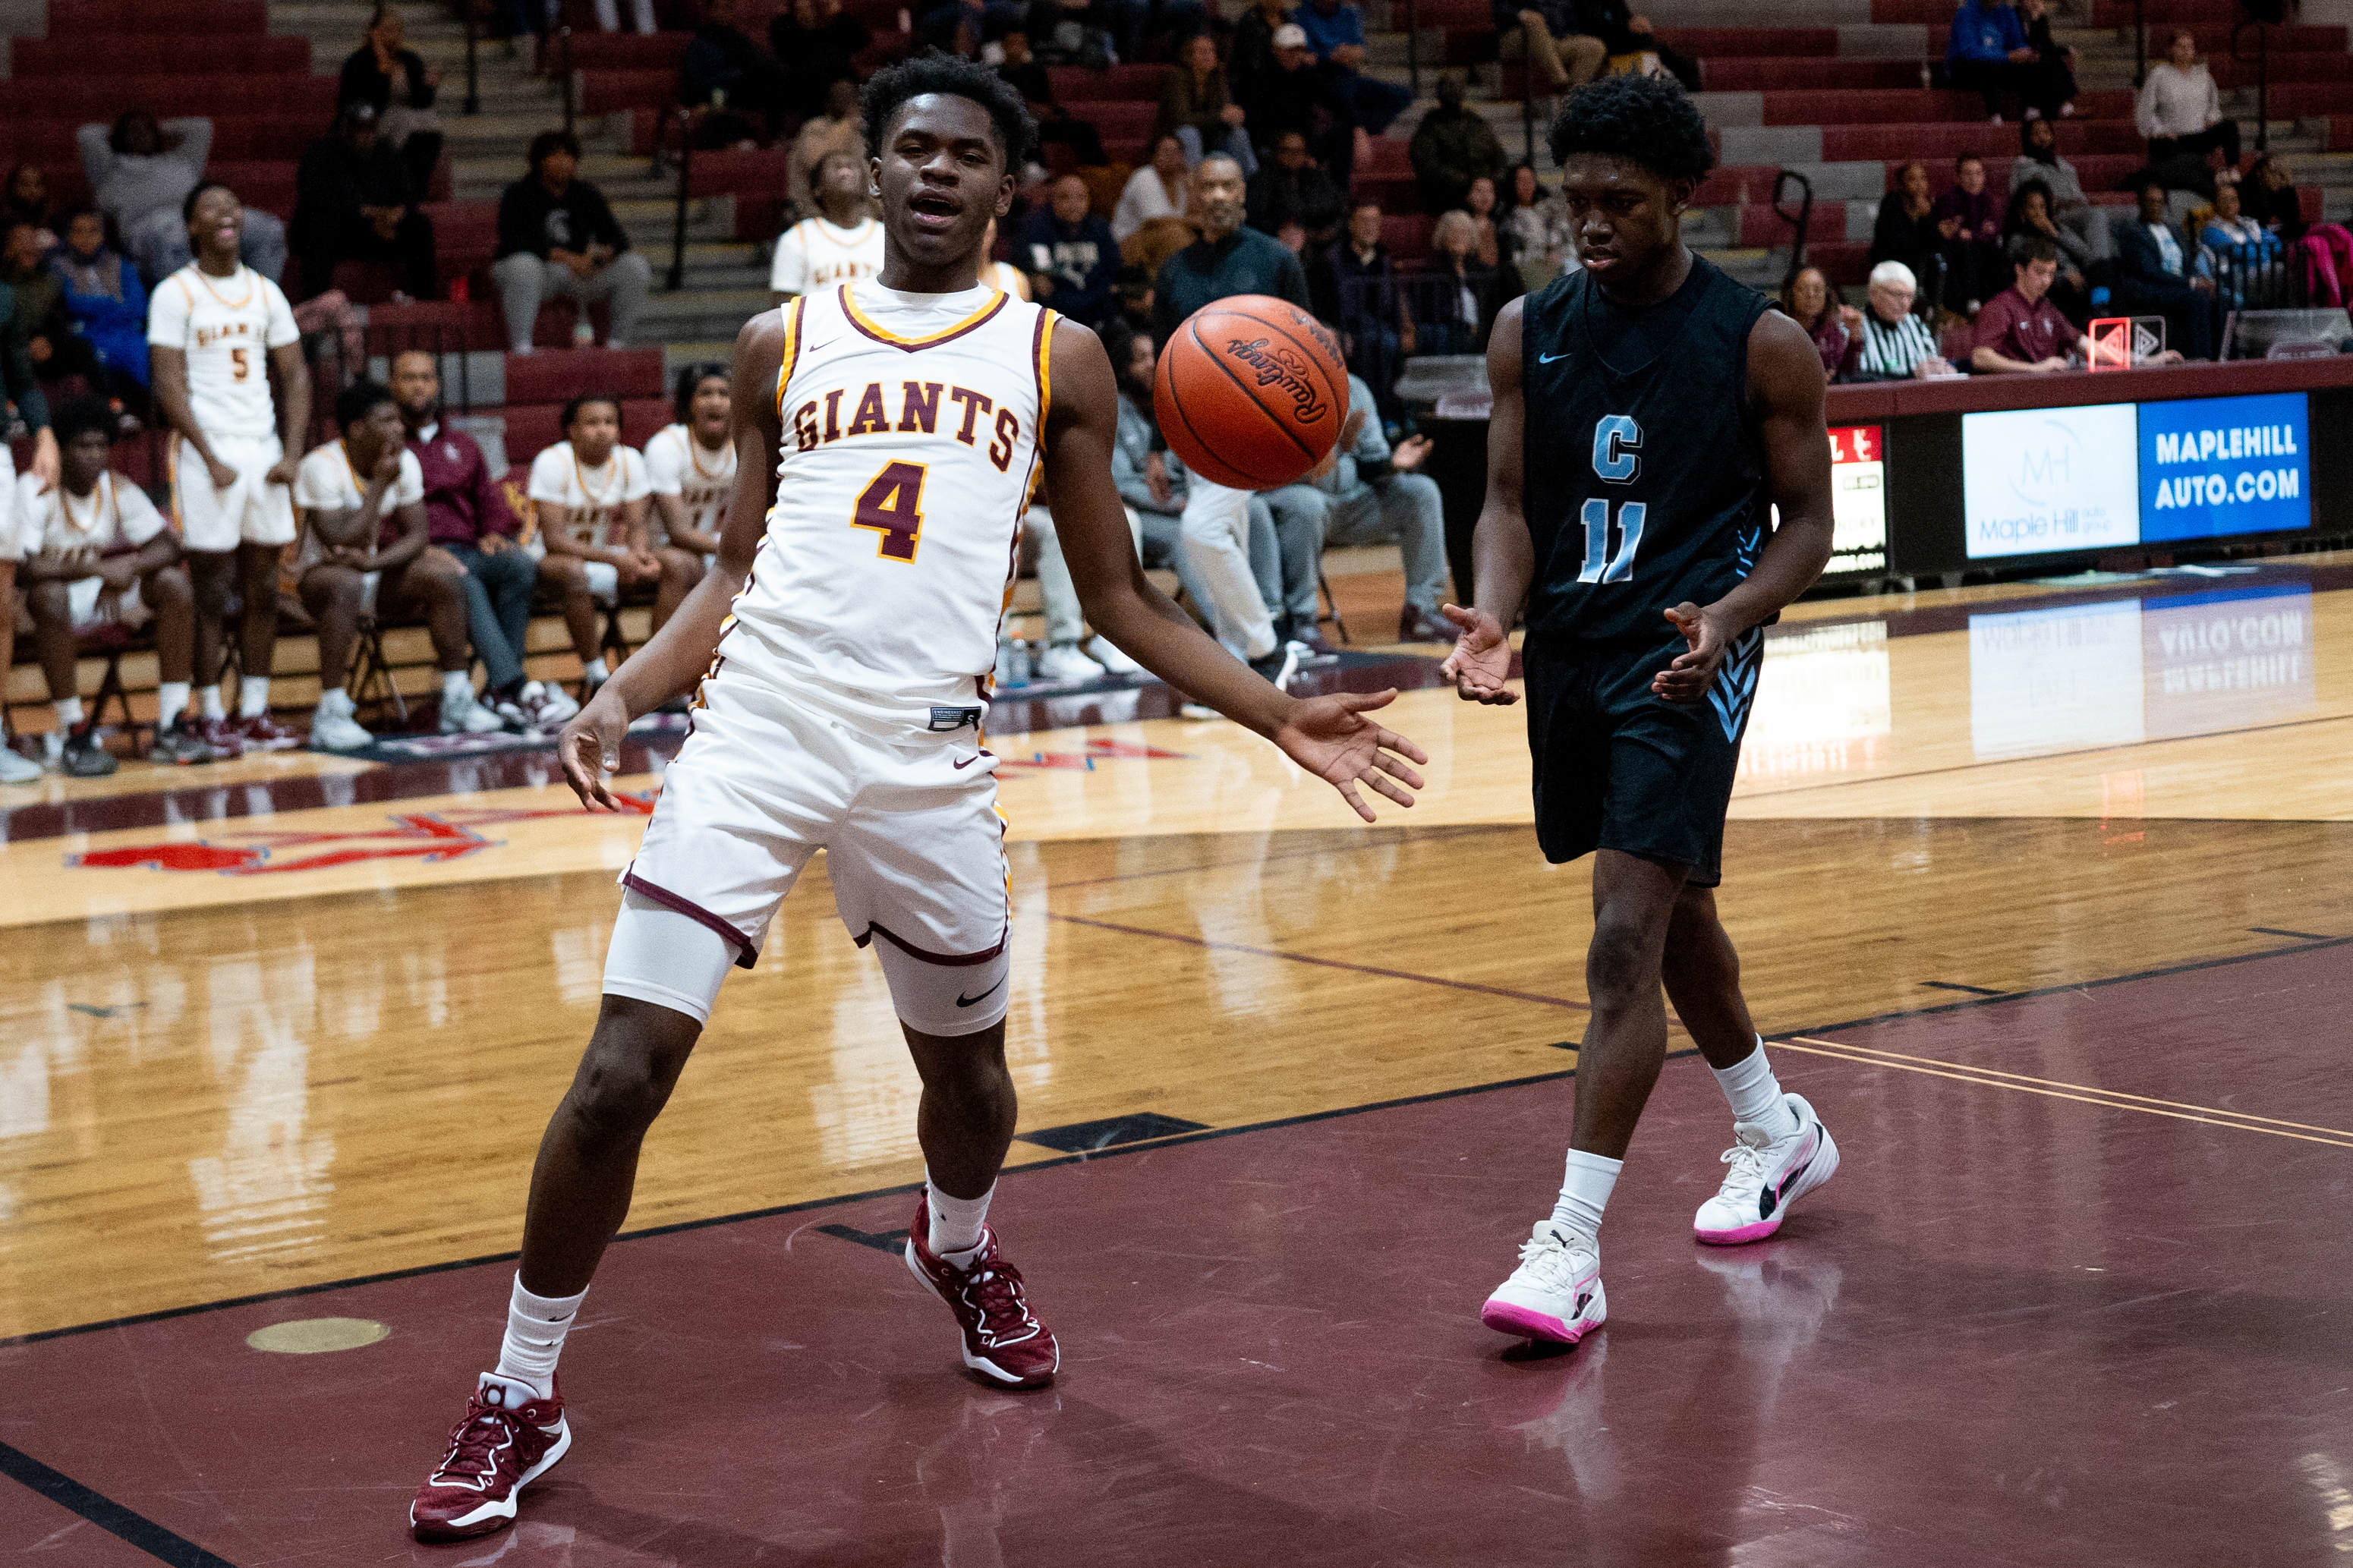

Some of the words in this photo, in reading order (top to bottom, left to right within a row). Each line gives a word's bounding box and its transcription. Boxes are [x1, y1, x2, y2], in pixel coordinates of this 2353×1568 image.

[231, 348, 249, 383] 5
[1227, 338, 1326, 424] Rawlings
[794, 380, 1020, 474] GIANTS
[2156, 423, 2298, 465] MAPLEHILL
[1592, 414, 1645, 486] C
[2022, 442, 2071, 486] MH
[849, 458, 930, 565] 4
[2153, 468, 2300, 511] AUTO.COM
[1980, 512, 2048, 545] Maple
[2052, 508, 2079, 535] Hill
[2082, 506, 2106, 518] auto
[1576, 497, 1648, 584] 11
